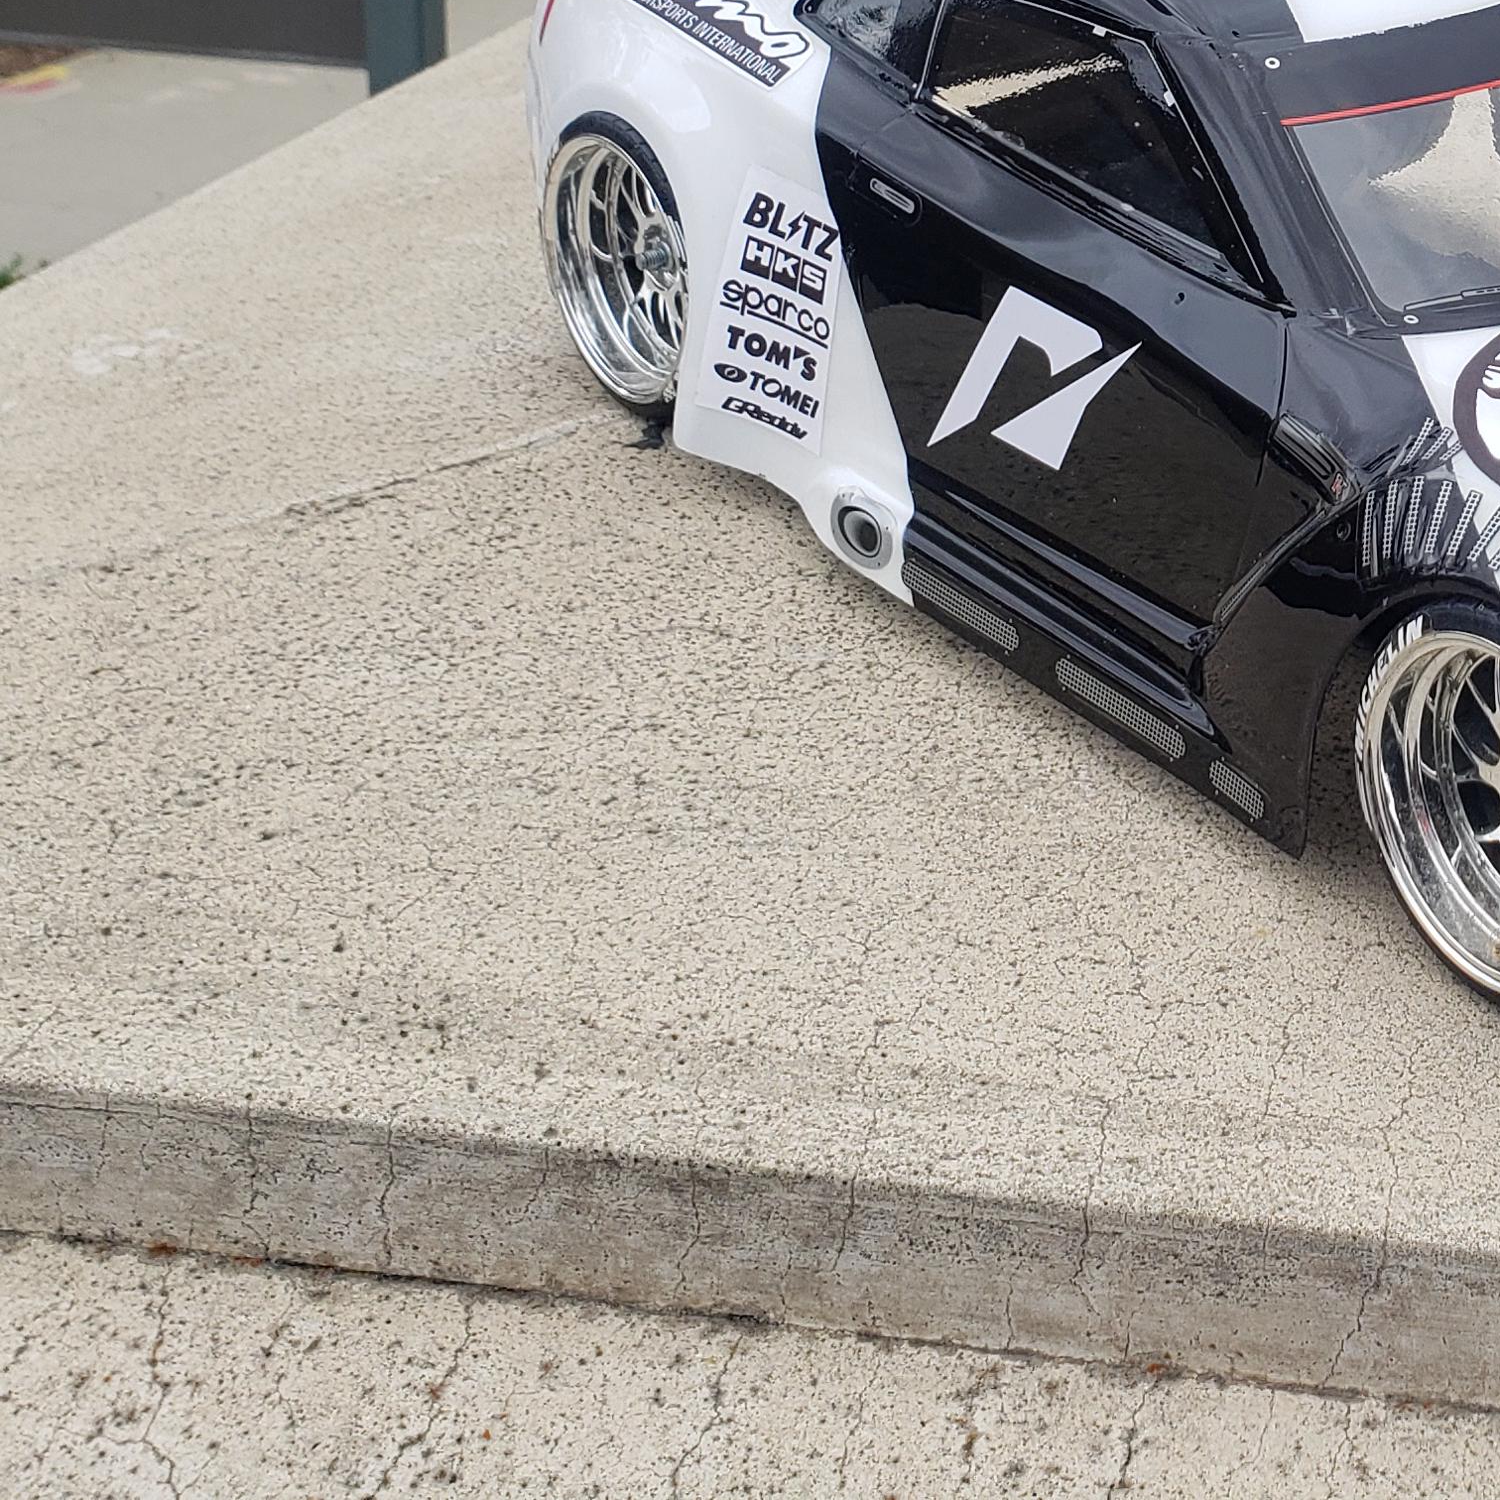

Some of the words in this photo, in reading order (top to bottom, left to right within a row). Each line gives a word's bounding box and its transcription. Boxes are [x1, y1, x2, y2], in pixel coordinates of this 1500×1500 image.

[693, 18, 783, 85] INTERNATIONAL
[743, 192, 839, 263] BLITZ
[741, 235, 828, 304] HKS
[720, 279, 831, 346] sparco
[726, 325, 818, 382] TOM'S
[749, 370, 820, 419] TOMEI
[1354, 614, 1424, 762] MICHELIN
